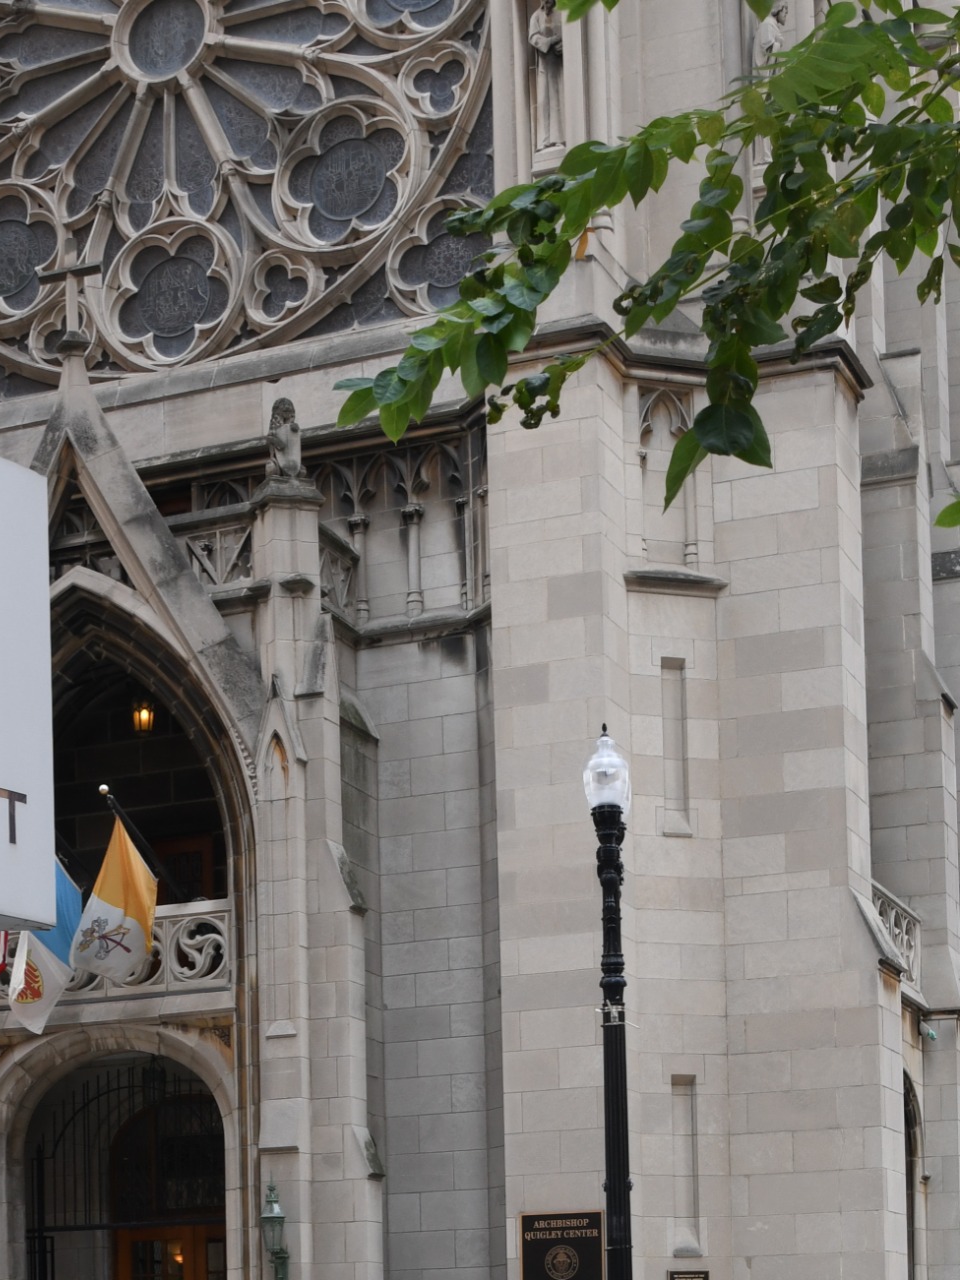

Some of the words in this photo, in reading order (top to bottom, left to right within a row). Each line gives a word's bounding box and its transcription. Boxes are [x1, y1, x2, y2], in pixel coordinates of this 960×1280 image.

[533, 1218, 589, 1229] ARCHBISHOP
[524, 1230, 563, 1240] QUIGLEY
[563, 1229, 599, 1239] CENTER
